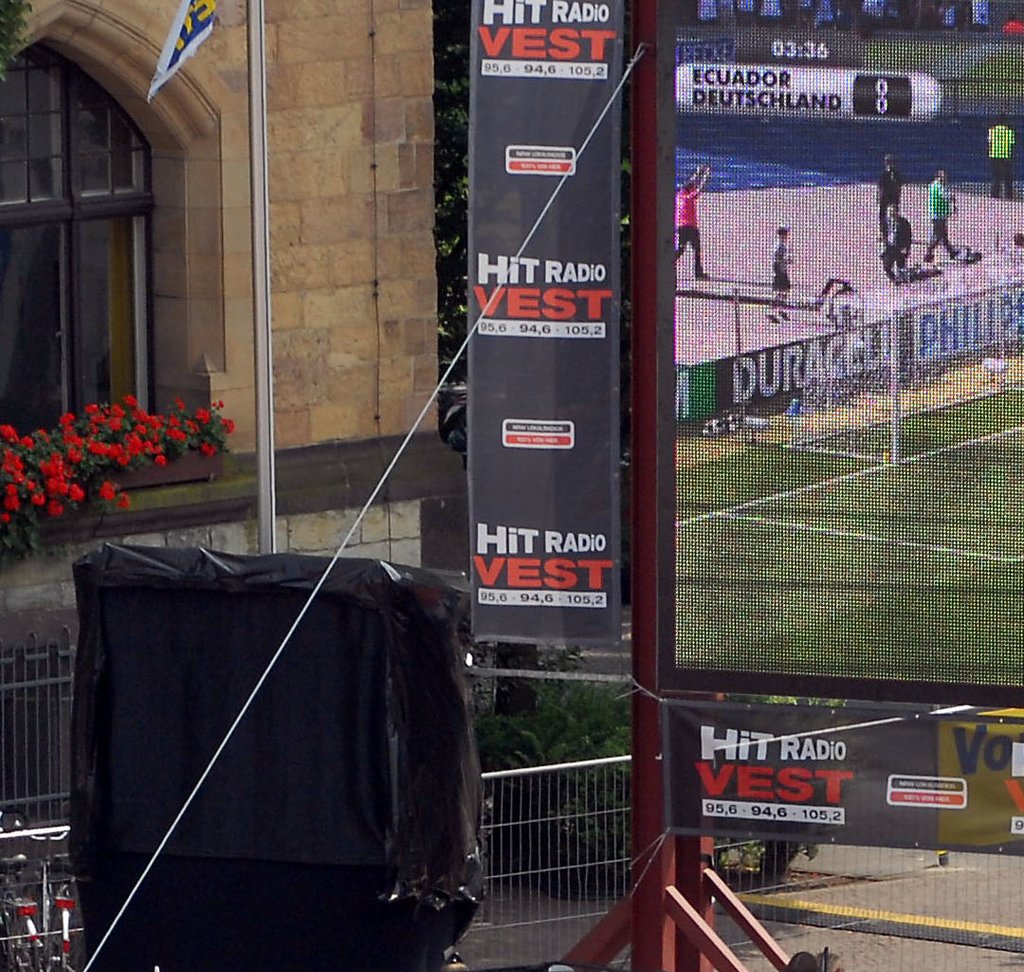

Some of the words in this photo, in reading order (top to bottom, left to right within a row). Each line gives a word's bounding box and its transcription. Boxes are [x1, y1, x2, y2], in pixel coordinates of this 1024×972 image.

[477, 26, 617, 61] VEST
[484, 63, 511, 74] 95,6
[524, 64, 556, 75] 94,6
[569, 66, 605, 77] 105,2
[693, 69, 791, 88] ECUADOR
[693, 90, 842, 110] DEUTSCHLAND
[473, 285, 614, 320] VEST
[480, 322, 507, 333] 95,6
[519, 324, 551, 335] 94,6
[565, 325, 602, 337] 105,2
[473, 555, 614, 590] VEST
[480, 592, 507, 603] 95,6
[520, 593, 553, 604] 94,6
[567, 594, 604, 606] 105,2
[695, 762, 854, 804] VEST
[705, 803, 737, 815] 95,6
[751, 806, 787, 818] 94,6
[802, 809, 841, 822] 105,2
